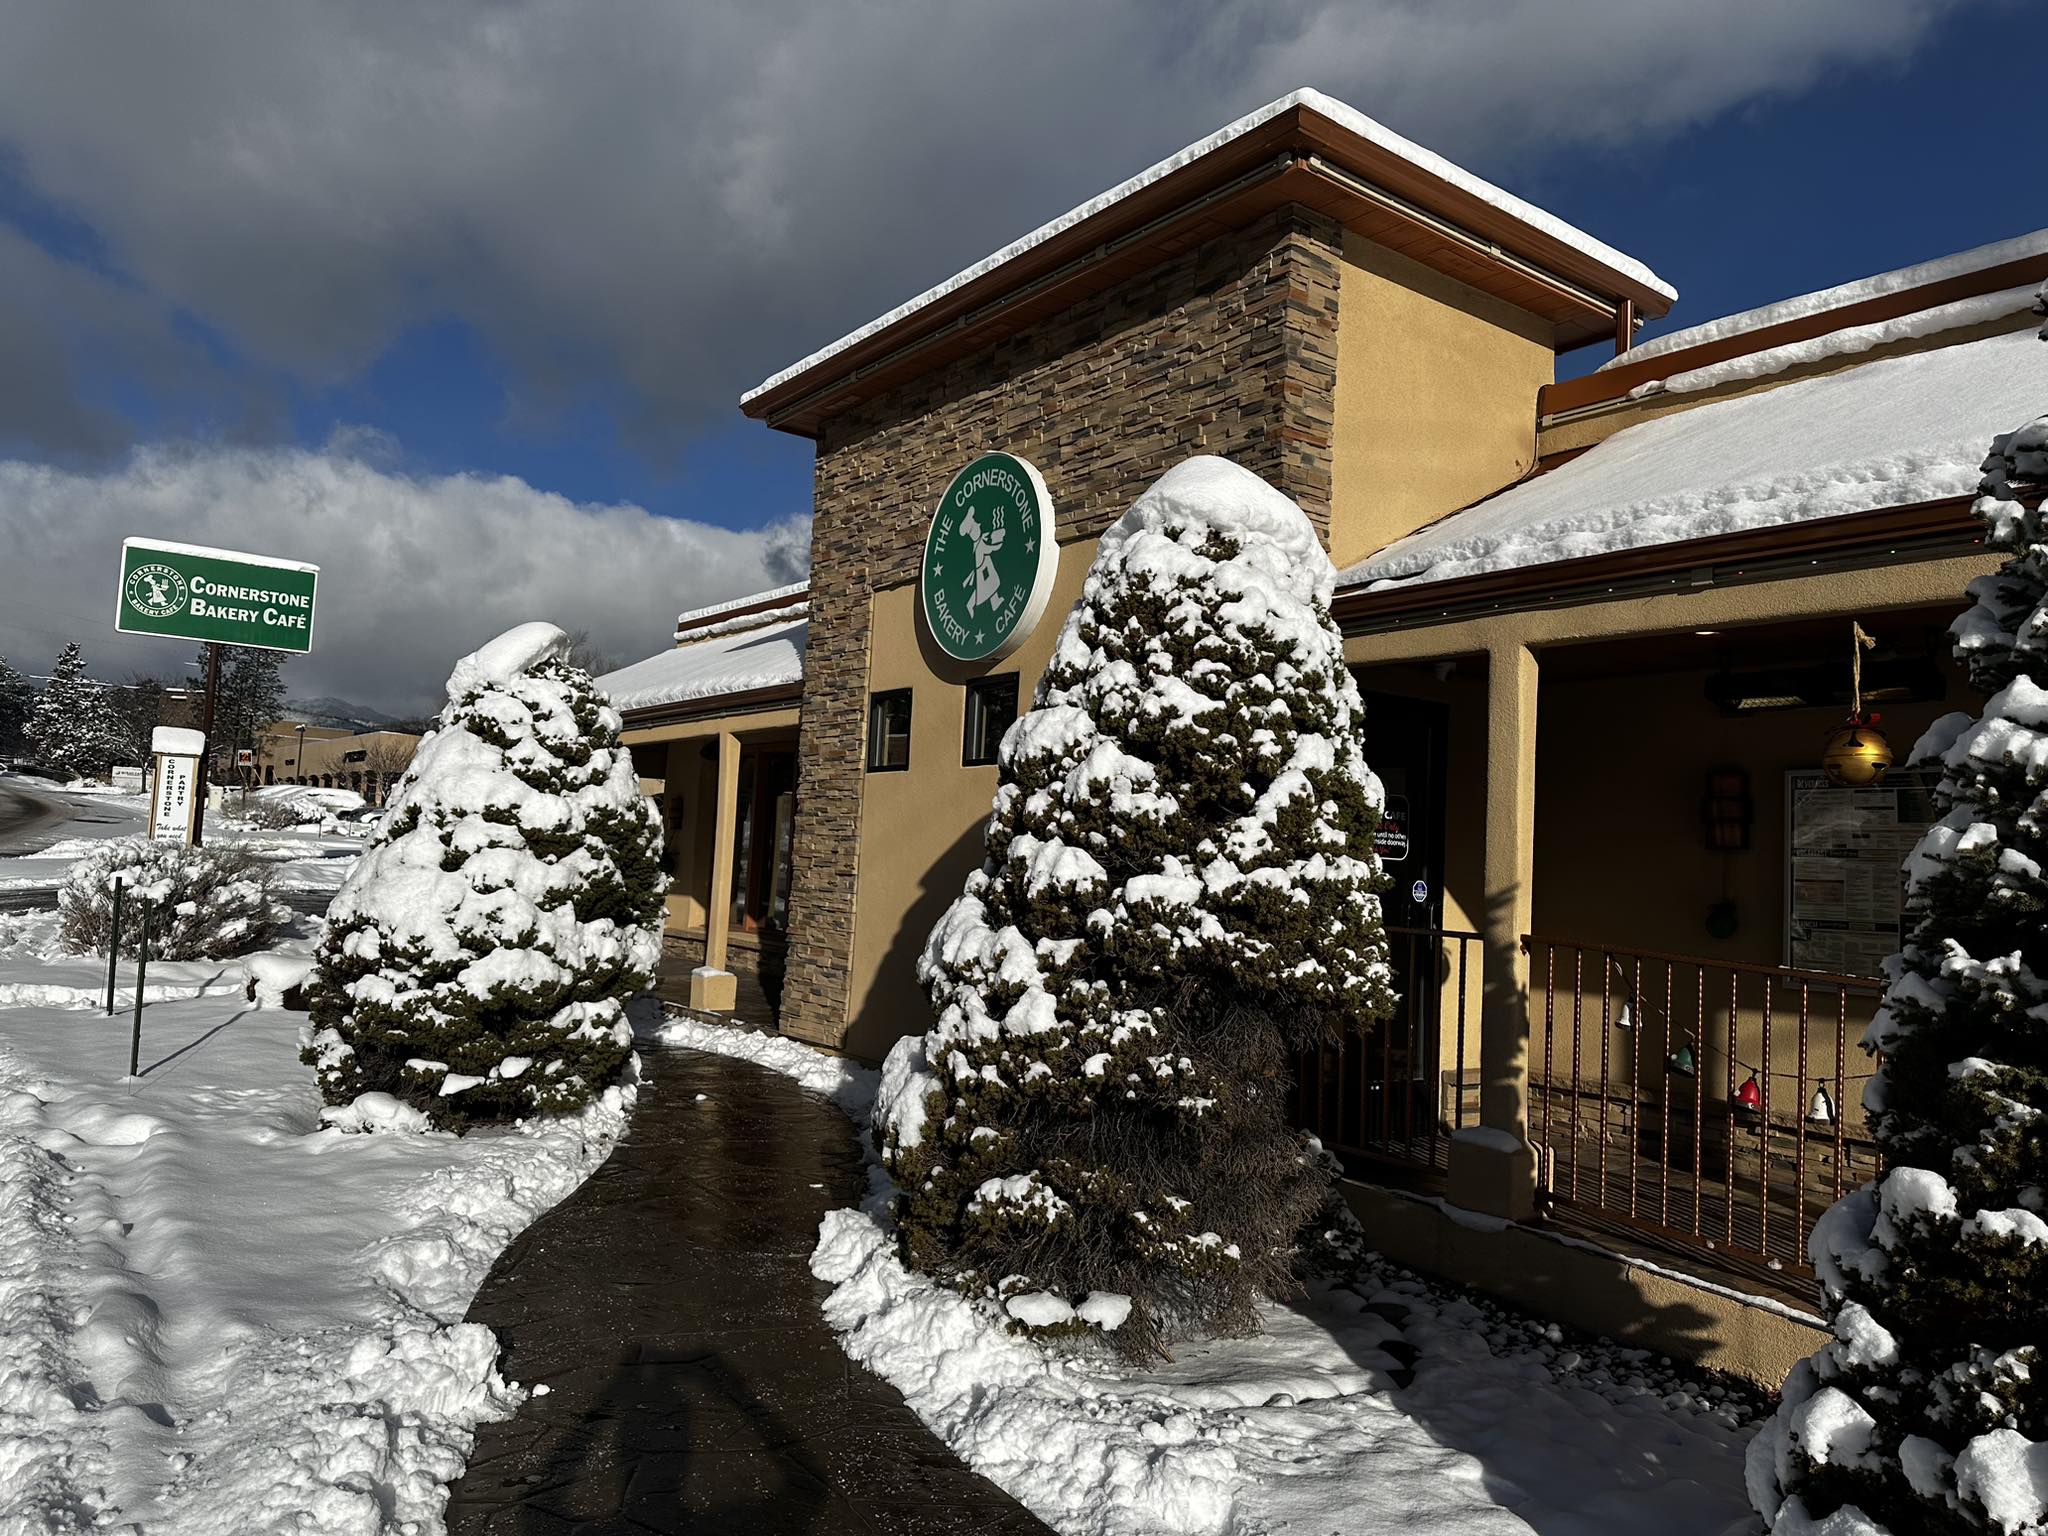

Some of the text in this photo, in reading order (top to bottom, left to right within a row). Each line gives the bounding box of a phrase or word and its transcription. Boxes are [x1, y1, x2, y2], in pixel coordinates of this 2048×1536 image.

[934, 468, 1034, 555] THE CORNERSTONE
[130, 566, 185, 591] CORNERSTONE
[190, 576, 310, 608] CORNERSTONE
[131, 599, 159, 615] BAKERY
[190, 597, 306, 629] BAKERY CAFÉ
[934, 584, 1026, 646] BAKERY CAFÉ
[164, 759, 175, 817] CORNERSTONE
[177, 775, 186, 806] PANTRY
